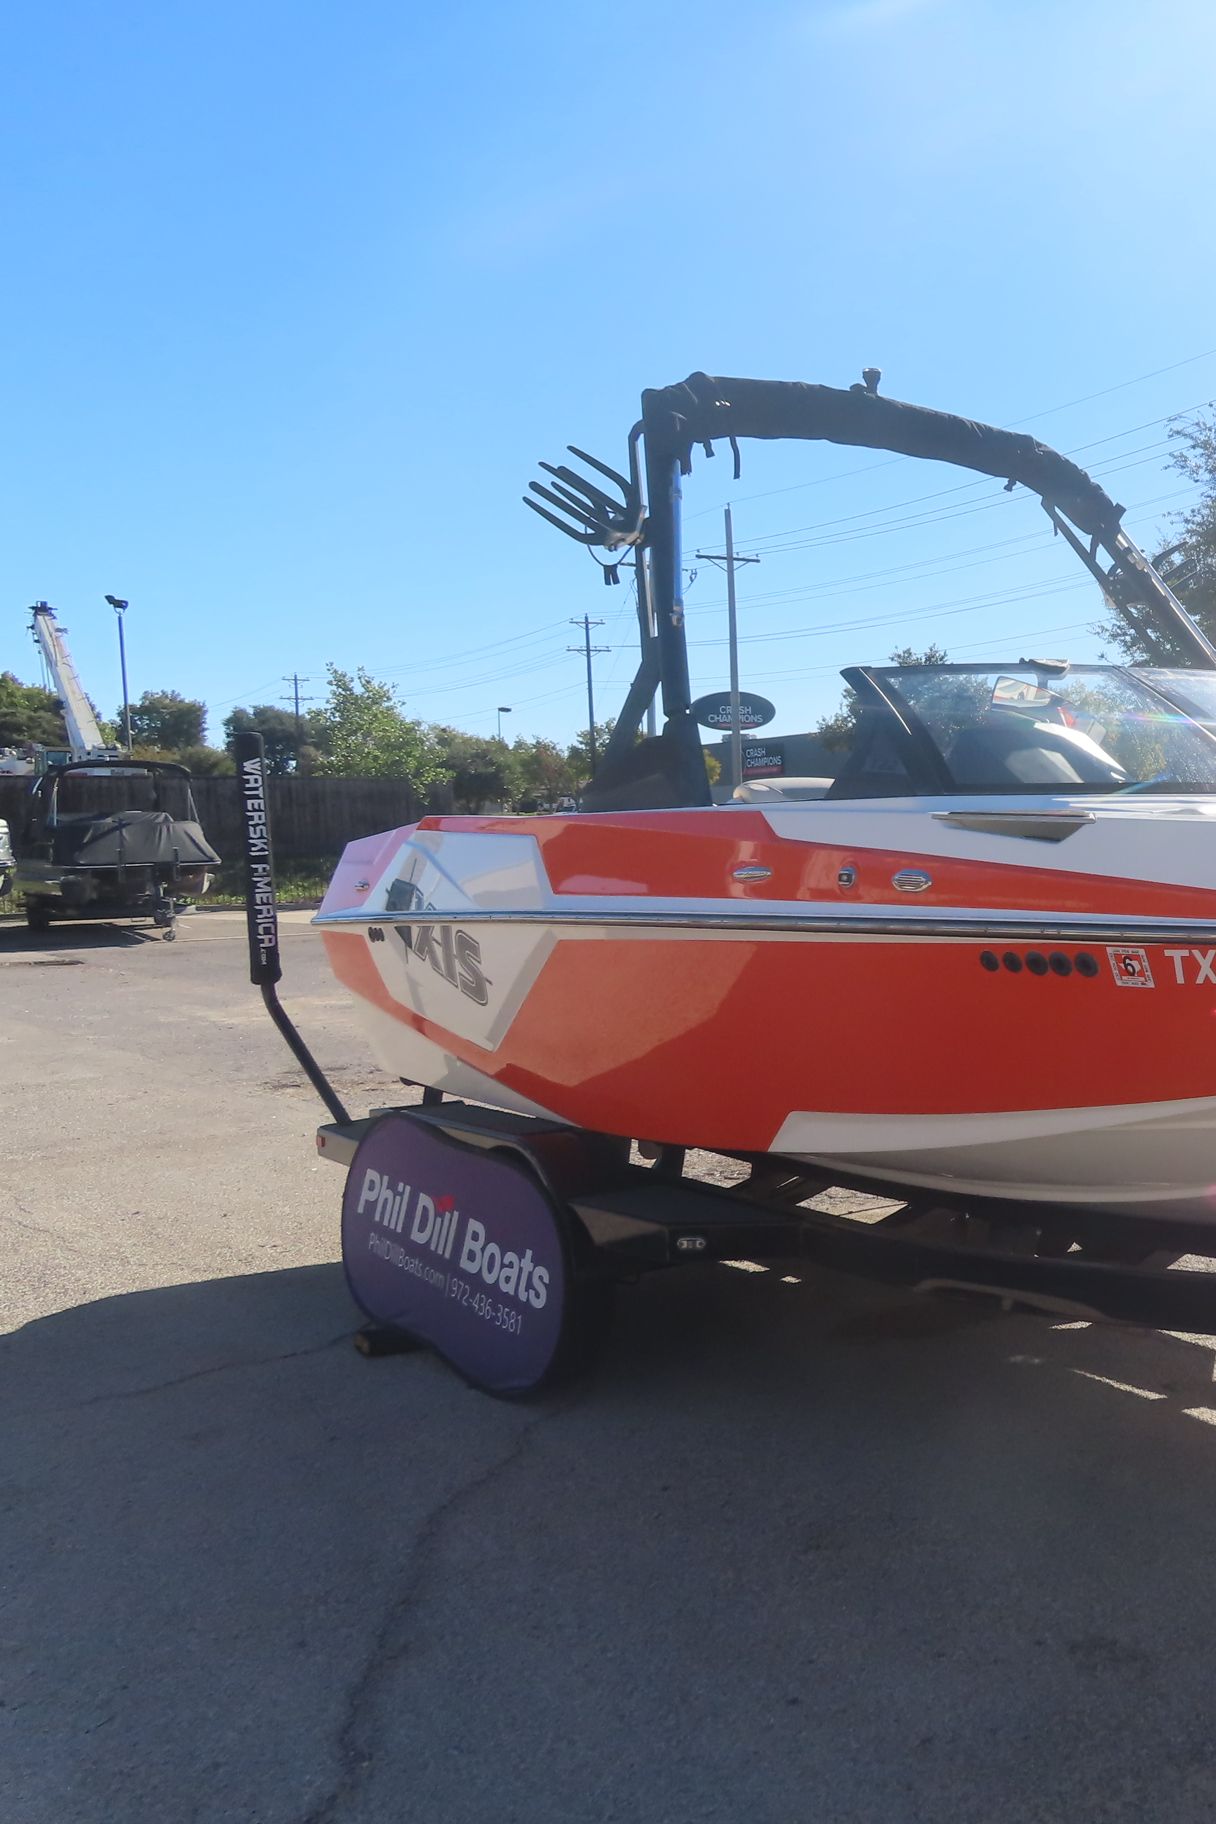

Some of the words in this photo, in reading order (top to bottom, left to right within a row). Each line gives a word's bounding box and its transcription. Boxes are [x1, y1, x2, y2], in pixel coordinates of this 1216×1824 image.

[719, 705, 752, 714] CRSH
[708, 714, 764, 723] CHAMIONS
[745, 748, 766, 757] CRASH
[746, 756, 782, 767] CHAMPIONS
[242, 757, 269, 856] WATERSKI
[357, 1168, 411, 1233] Phil
[410, 1193, 459, 1259] Dill
[460, 1217, 550, 1309] Boats
[450, 1278, 522, 1335] 972-436-3581
